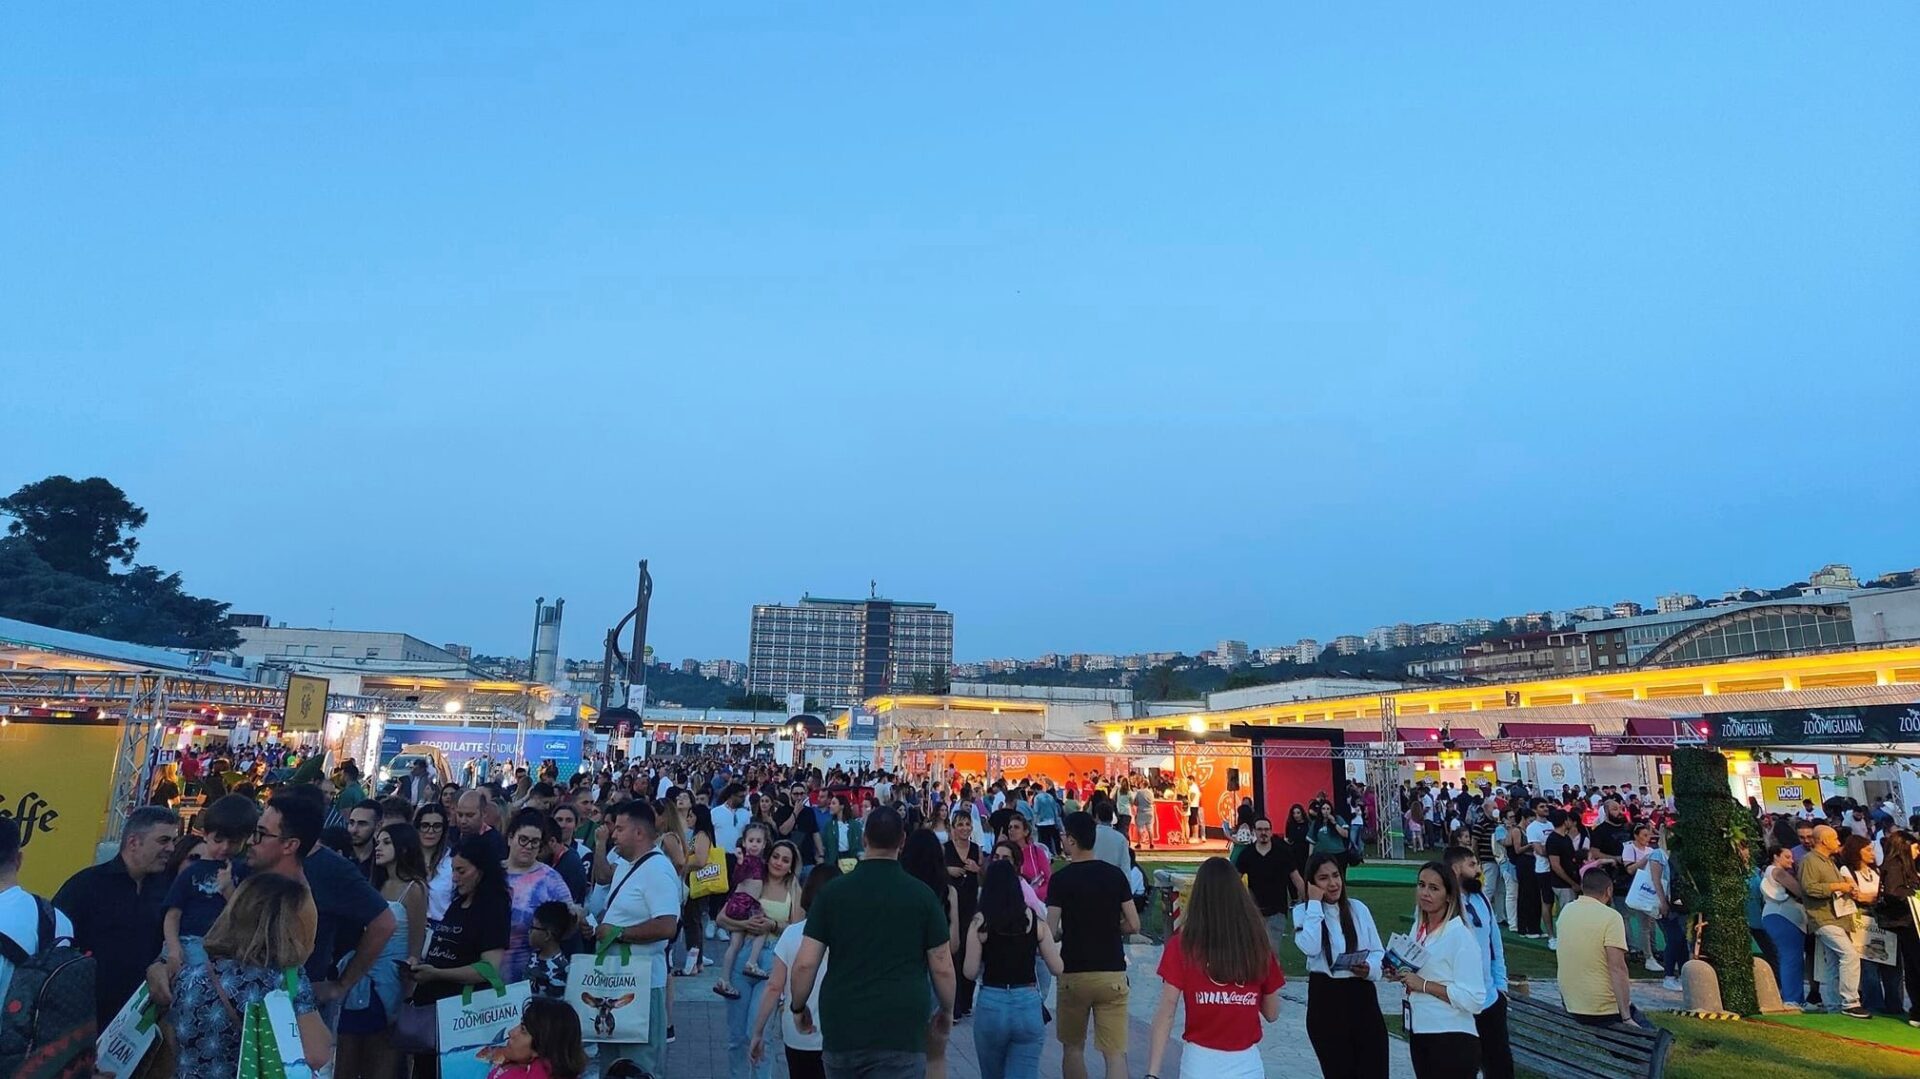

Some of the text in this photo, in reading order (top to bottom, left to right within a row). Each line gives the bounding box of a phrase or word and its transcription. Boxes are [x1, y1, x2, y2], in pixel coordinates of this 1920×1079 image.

[1510, 694, 1517, 704] 2
[1721, 722, 1775, 737] ZOOMIGUANA
[1803, 719, 1865, 735] ZOOMIGUANA
[580, 974, 637, 988] ZOOMIGUANA
[452, 1005, 519, 1031] ZOOMIGUANA
